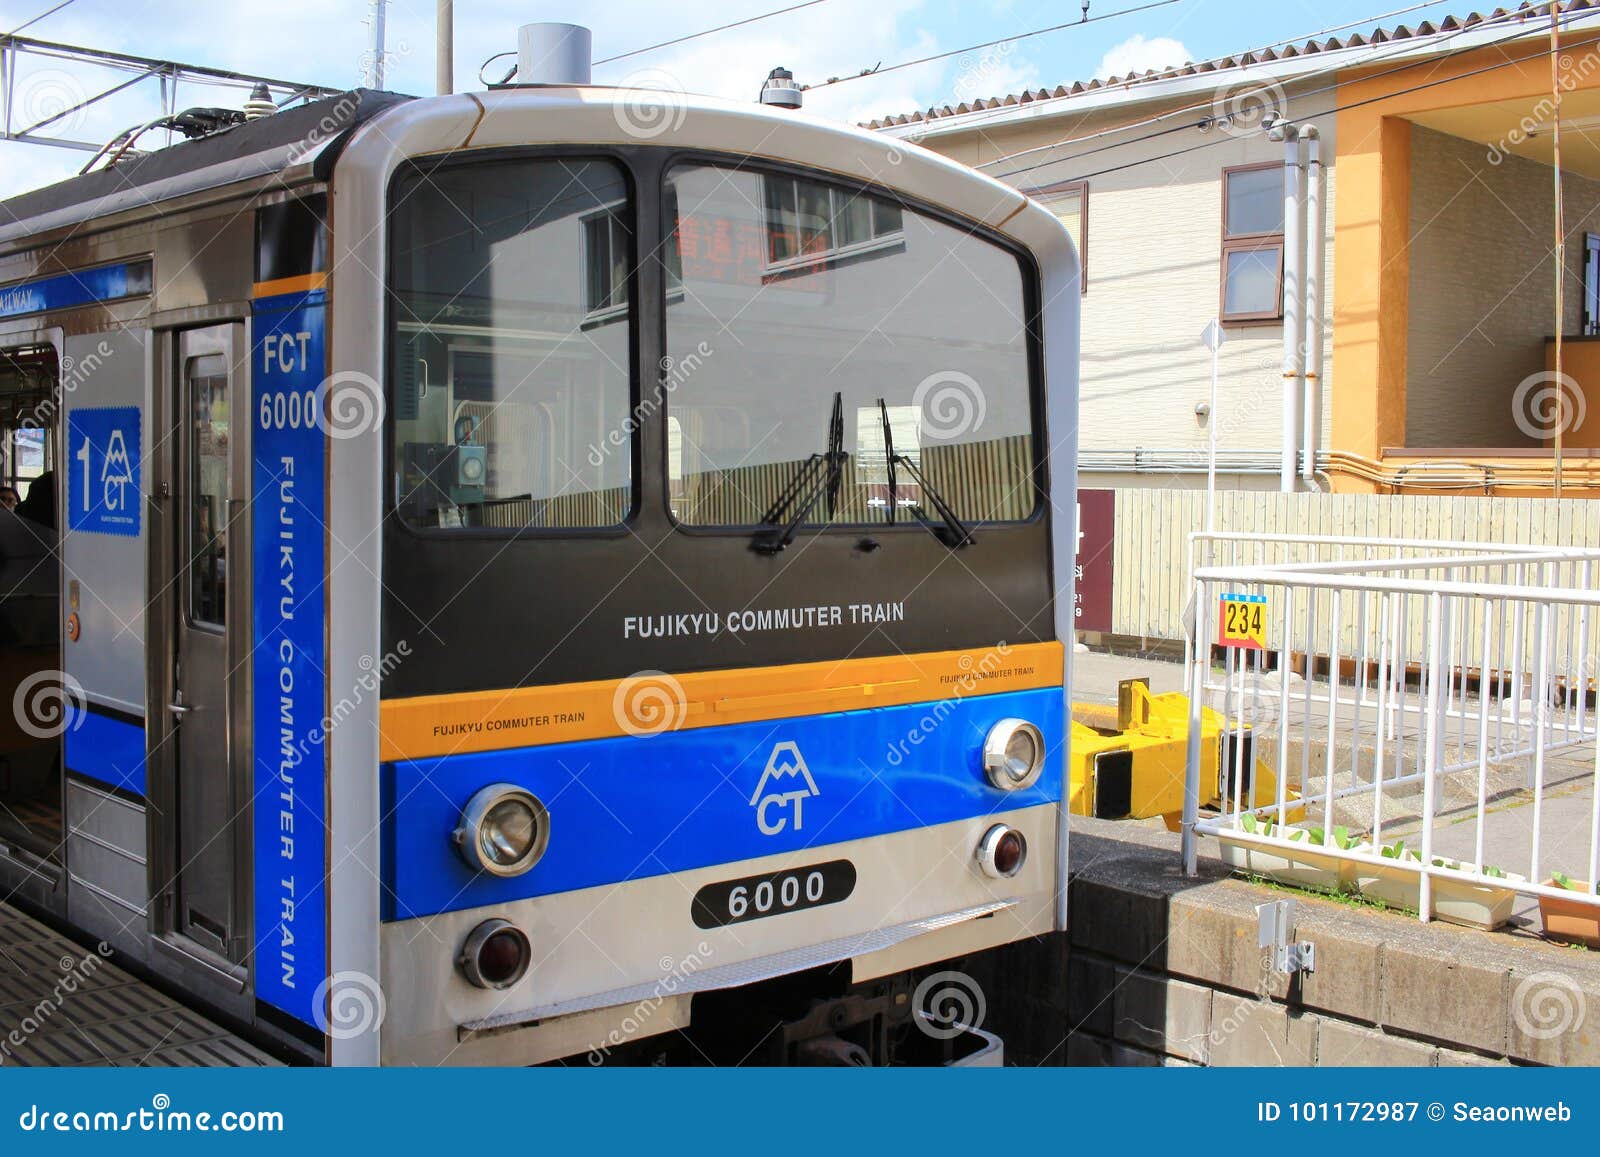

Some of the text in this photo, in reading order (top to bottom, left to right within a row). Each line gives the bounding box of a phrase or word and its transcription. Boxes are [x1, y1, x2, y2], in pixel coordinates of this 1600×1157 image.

[264, 332, 311, 374] FCT
[261, 390, 317, 430] 6000
[77, 436, 90, 512] 1
[624, 602, 905, 639] FUJIKYU COMMUTER TRAIN
[1227, 603, 1261, 635] 234
[940, 667, 1034, 684] FUJIKYU COMMUTER TRAIN
[279, 456, 295, 989] FUJIKYU COMMUTER TRAIN
[433, 712, 585, 737] FUJIKYU COMMUTER TRAIN
[728, 871, 824, 917] 6000
